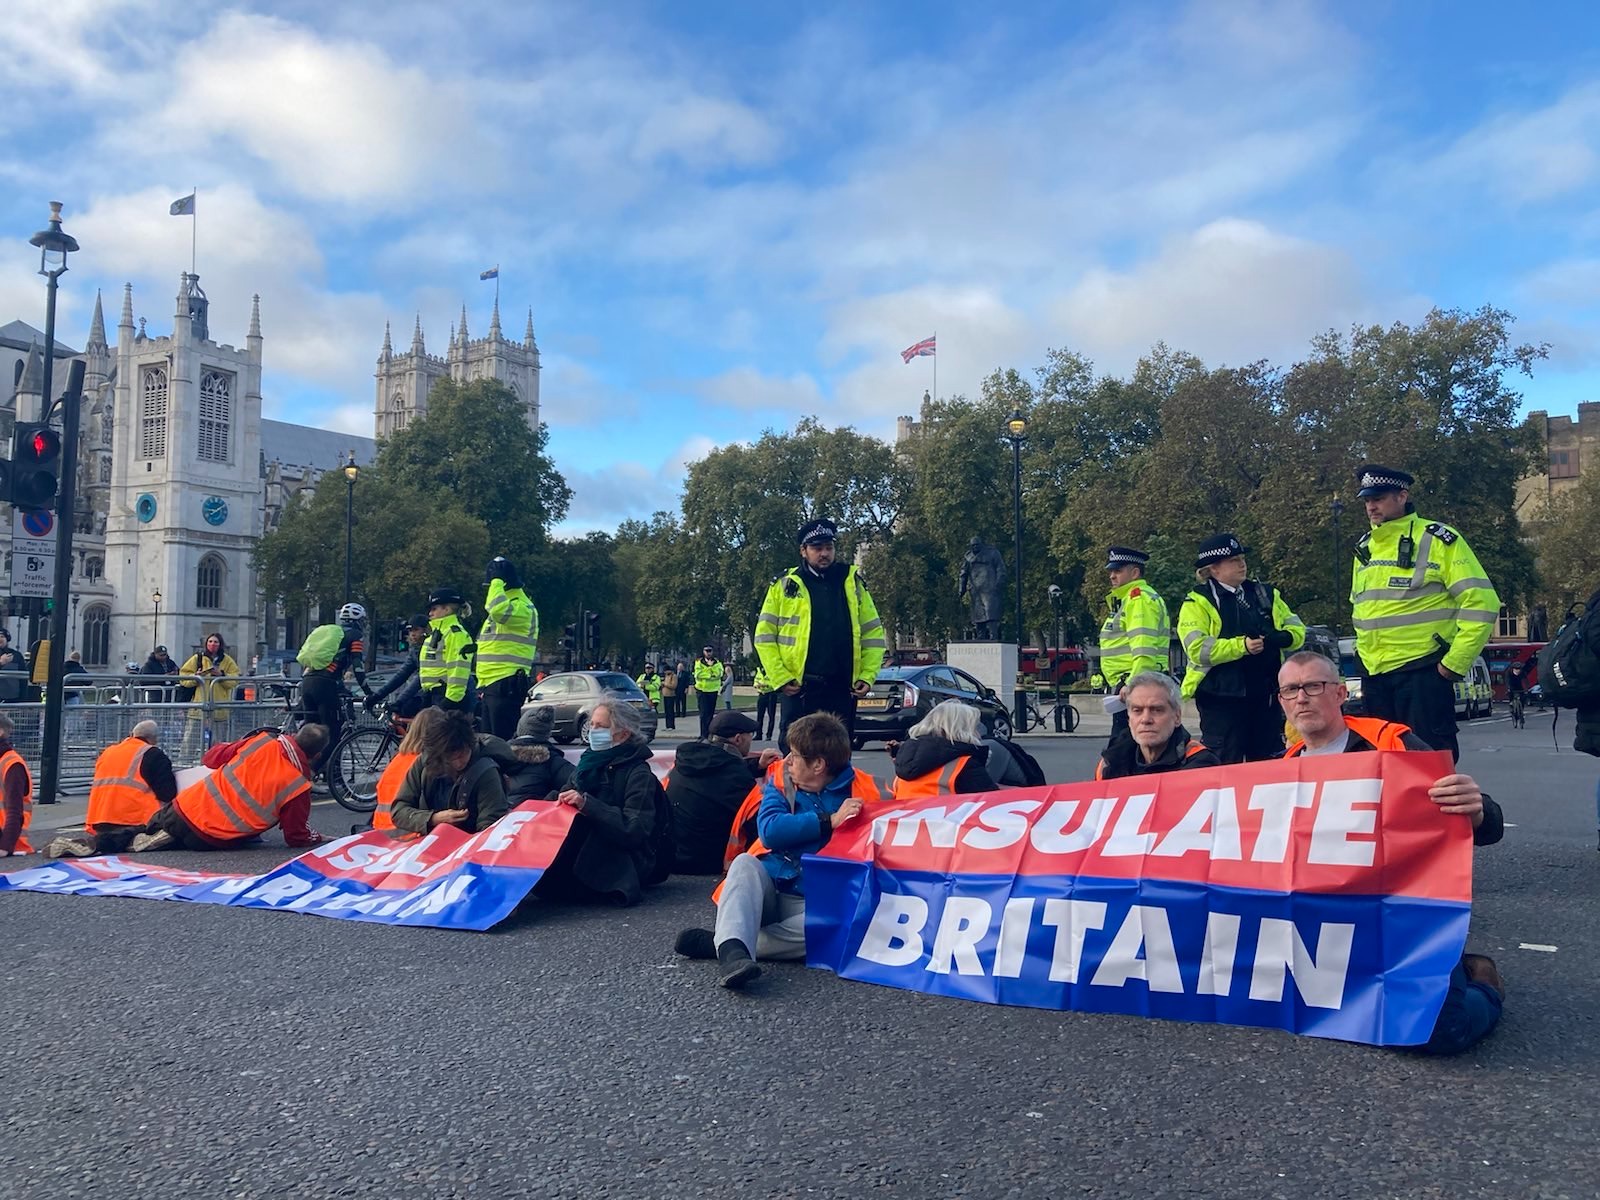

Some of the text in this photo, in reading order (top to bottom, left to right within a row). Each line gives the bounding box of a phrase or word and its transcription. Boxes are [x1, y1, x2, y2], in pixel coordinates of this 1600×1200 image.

[949, 647, 999, 657] CHURCHILL
[866, 778, 1383, 867] INSULATE
[856, 892, 1355, 1009] BRITAIN
